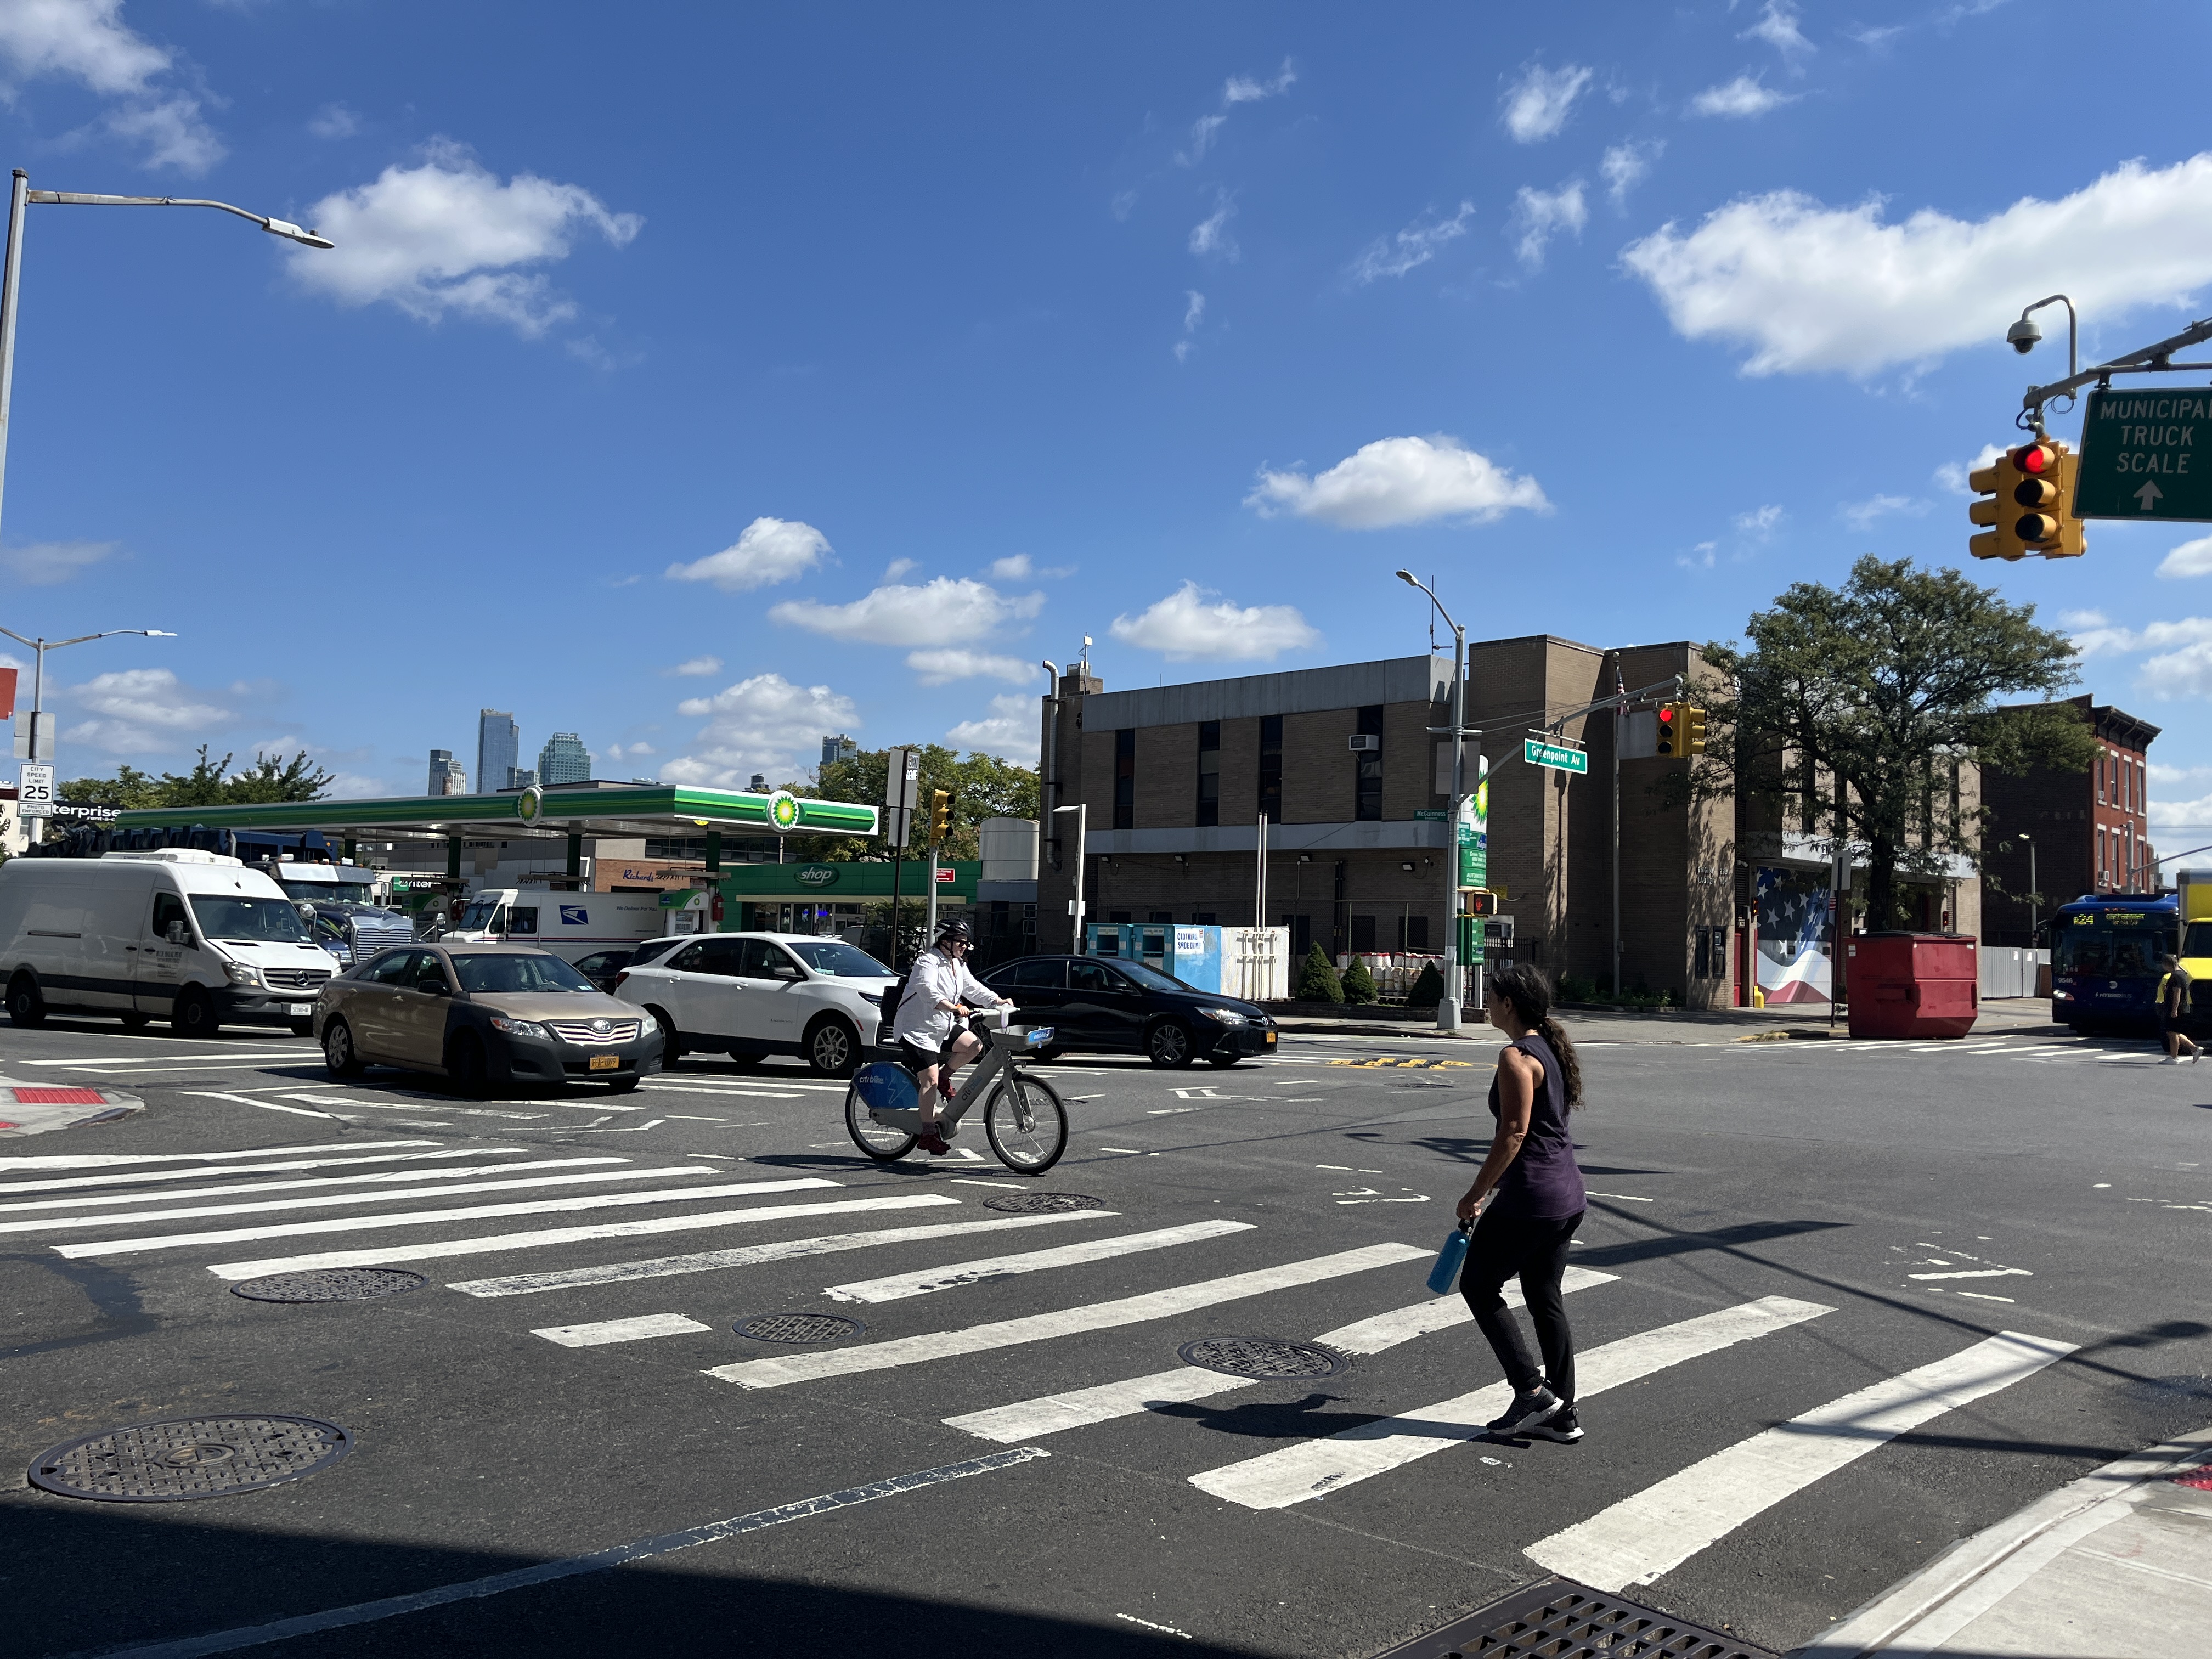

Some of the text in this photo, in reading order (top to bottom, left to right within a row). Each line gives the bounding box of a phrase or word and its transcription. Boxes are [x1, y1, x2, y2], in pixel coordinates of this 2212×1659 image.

[2121, 425, 2194, 446] TRUCK
[2117, 453, 2191, 473] SCALE
[1531, 745, 1580, 765] Greenpoint Av
[24, 785, 49, 799] 25
[53, 804, 121, 818] terprise
[801, 867, 832, 883] shop
